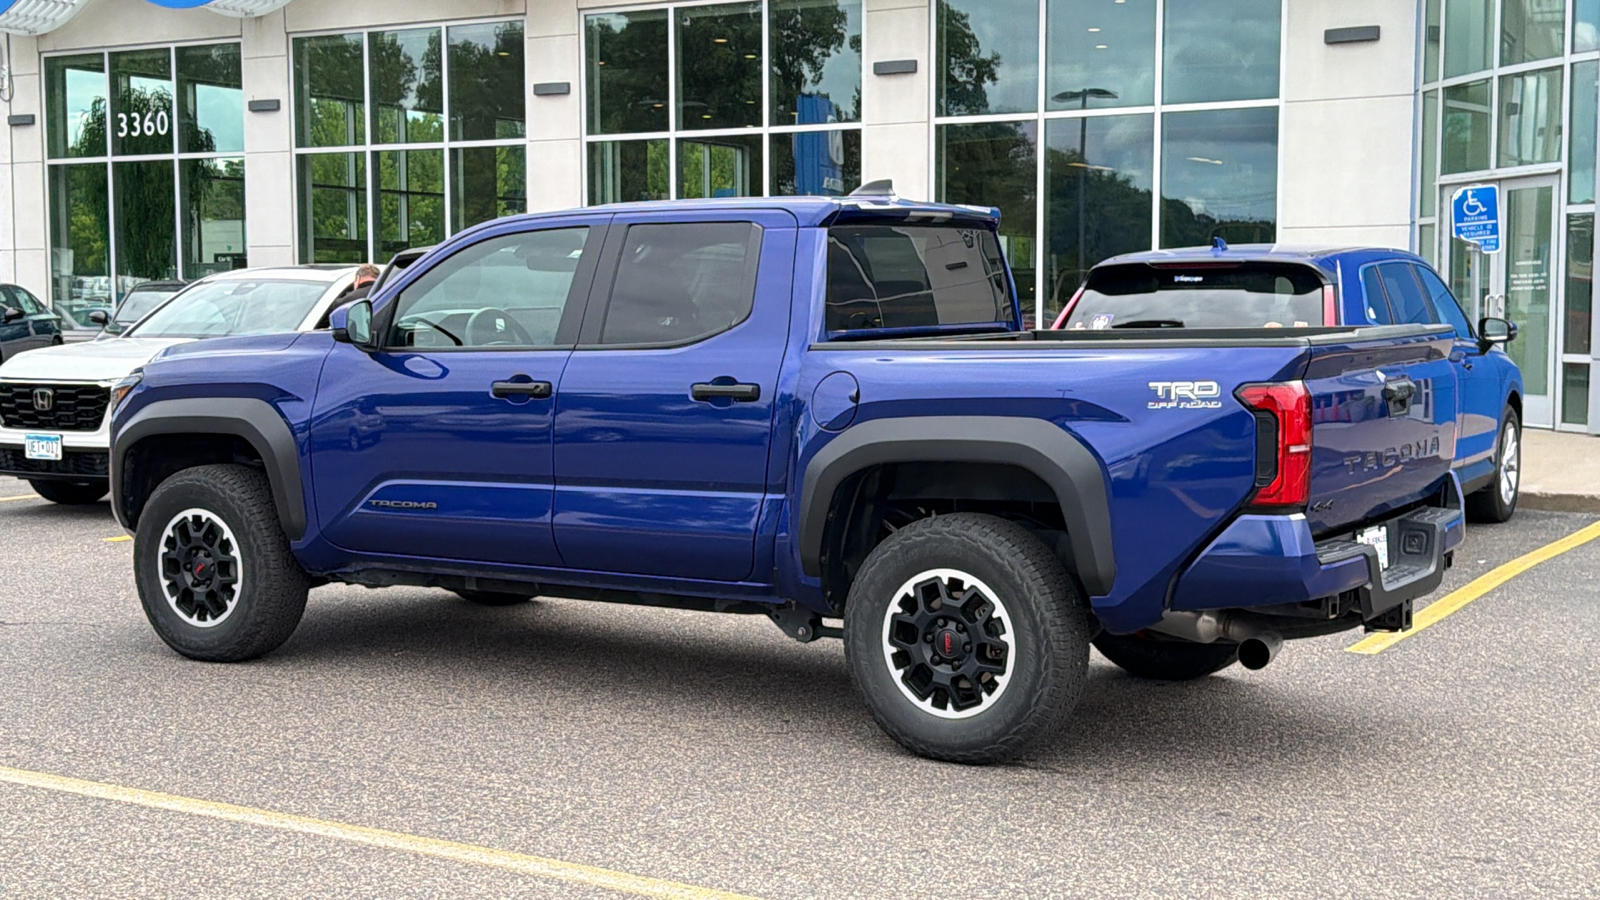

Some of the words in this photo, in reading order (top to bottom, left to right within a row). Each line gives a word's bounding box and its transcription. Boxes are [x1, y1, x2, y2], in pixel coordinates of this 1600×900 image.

[117, 110, 169, 137] 3360
[1148, 381, 1221, 401] TRD
[1147, 401, 1177, 409] OFF
[1179, 400, 1222, 409] ROAD
[1342, 436, 1441, 475] TACOMA
[368, 499, 437, 509] TACOMA
